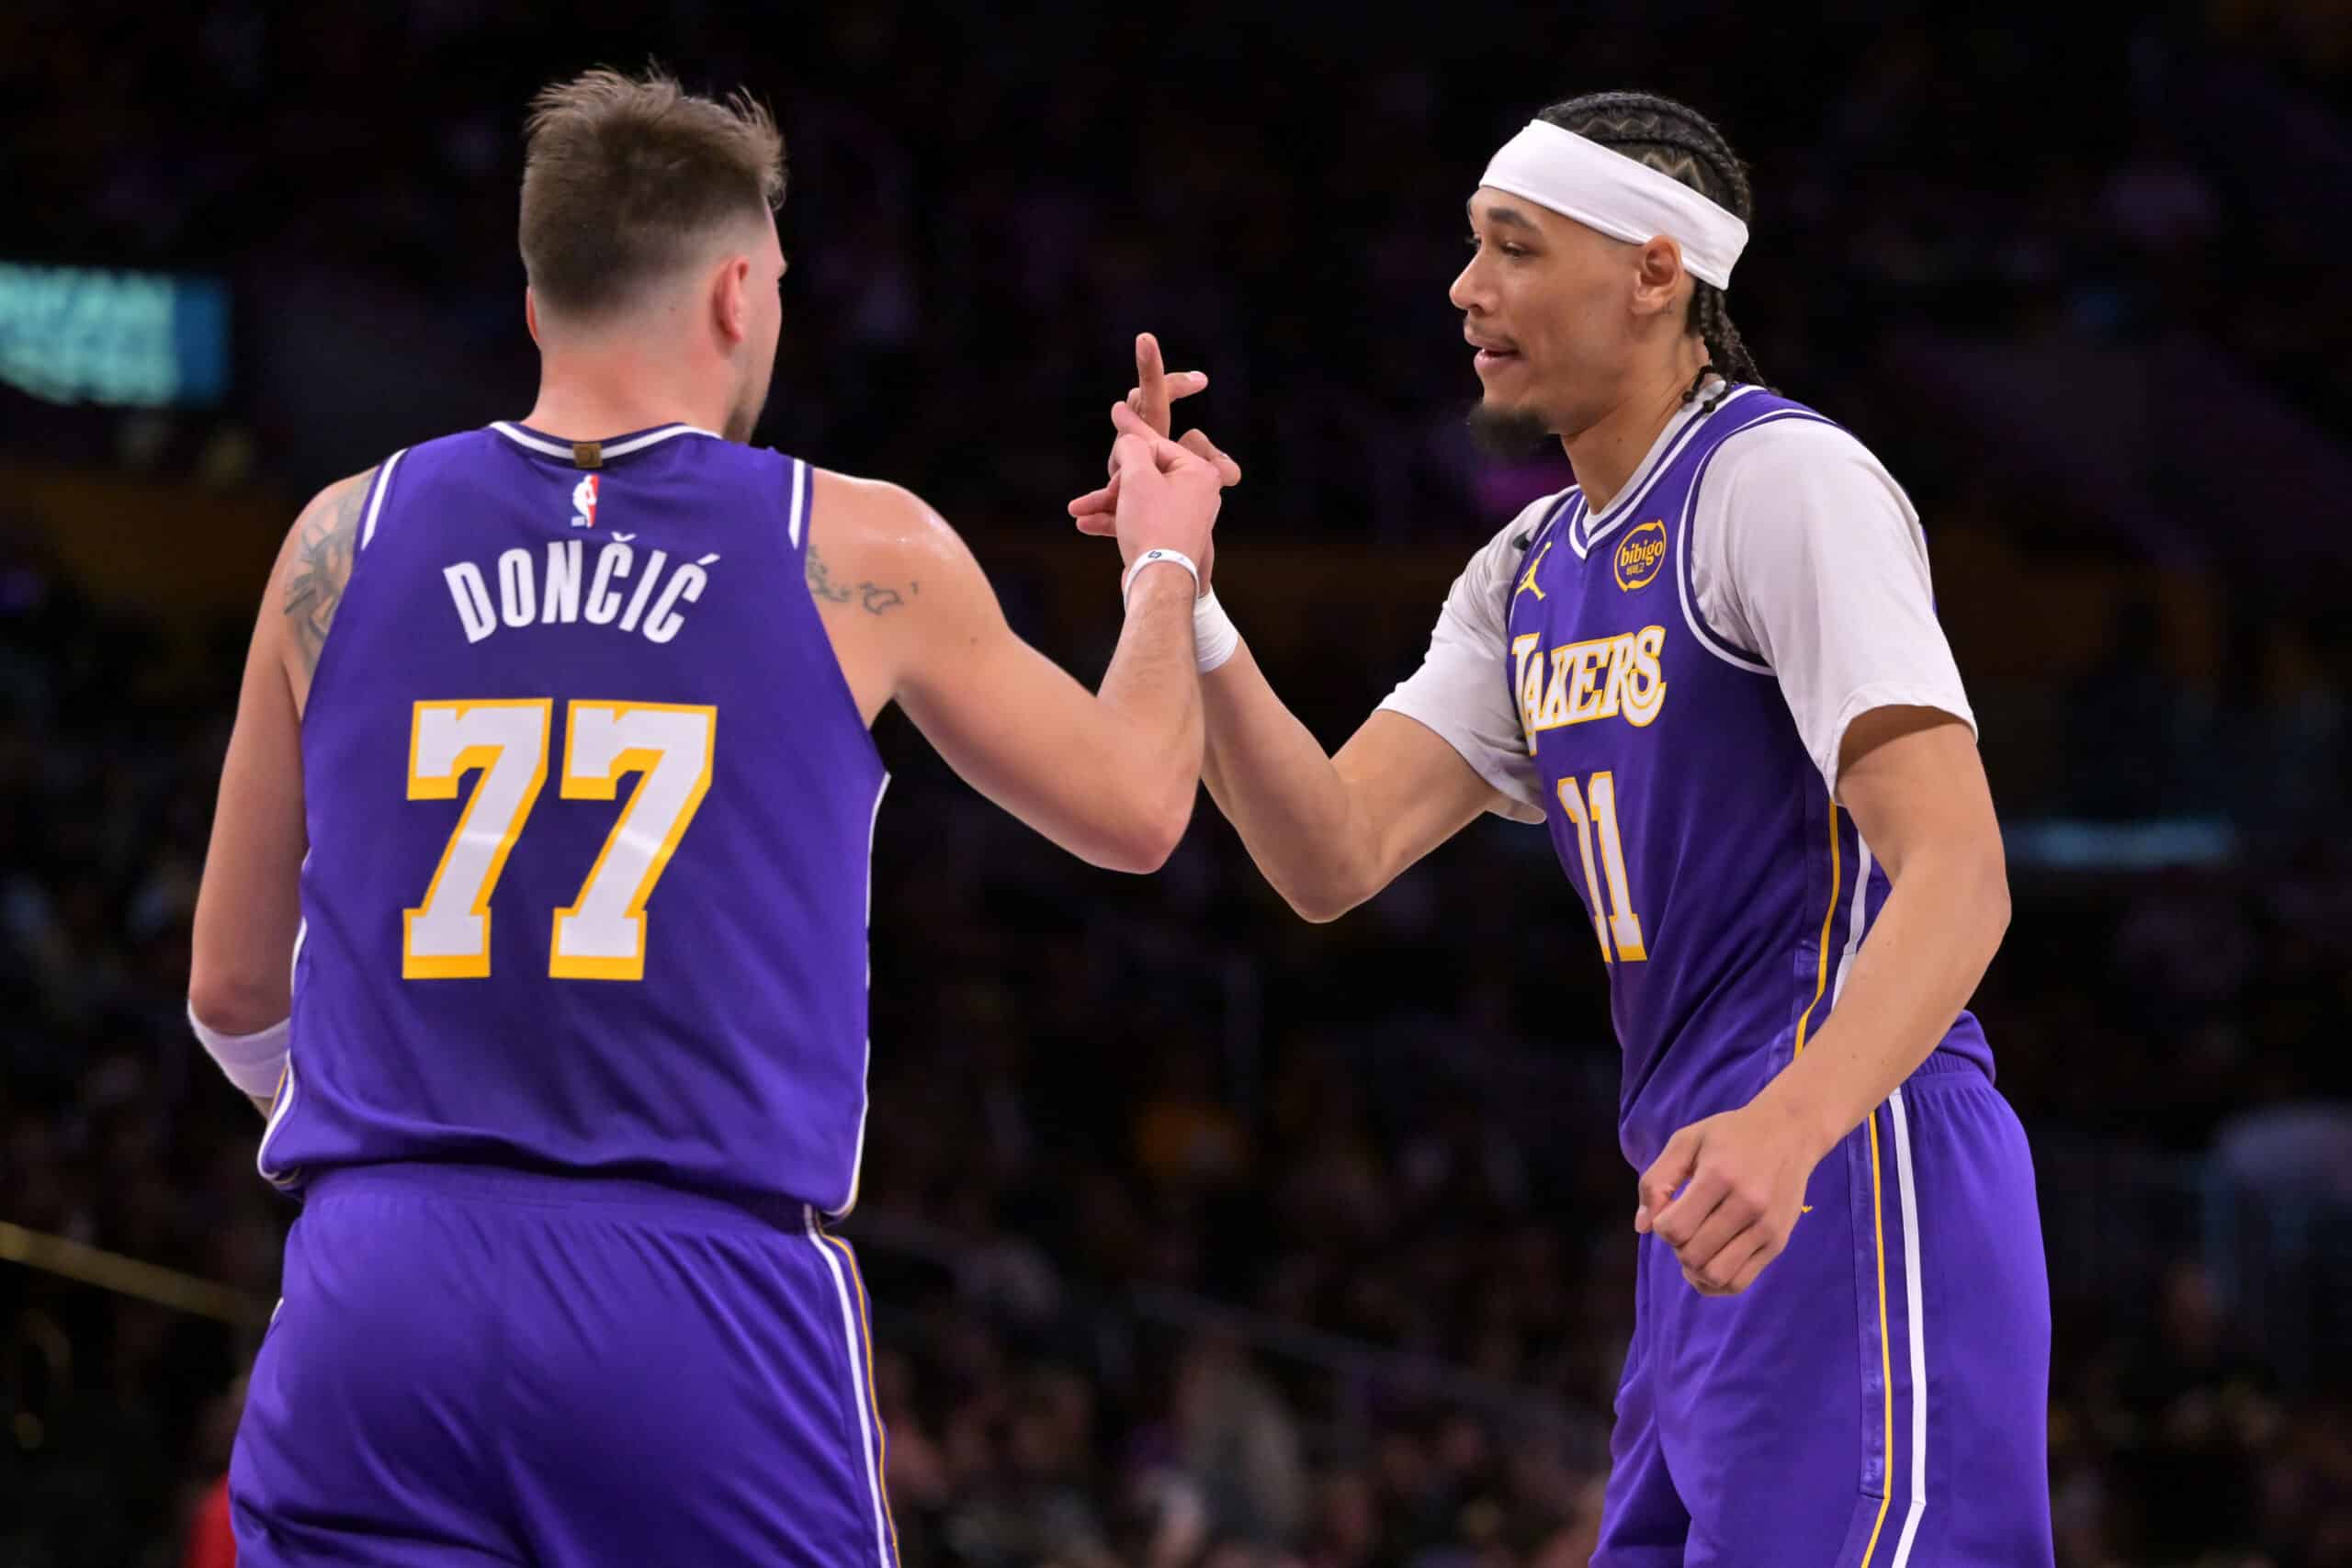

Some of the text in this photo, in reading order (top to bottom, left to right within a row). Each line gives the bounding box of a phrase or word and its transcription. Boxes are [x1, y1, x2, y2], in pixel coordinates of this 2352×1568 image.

[443, 531, 720, 643] DONČIĆ
[1621, 539, 1663, 567] bibigo
[402, 698, 718, 980] 77
[1557, 772, 1647, 964] 11
